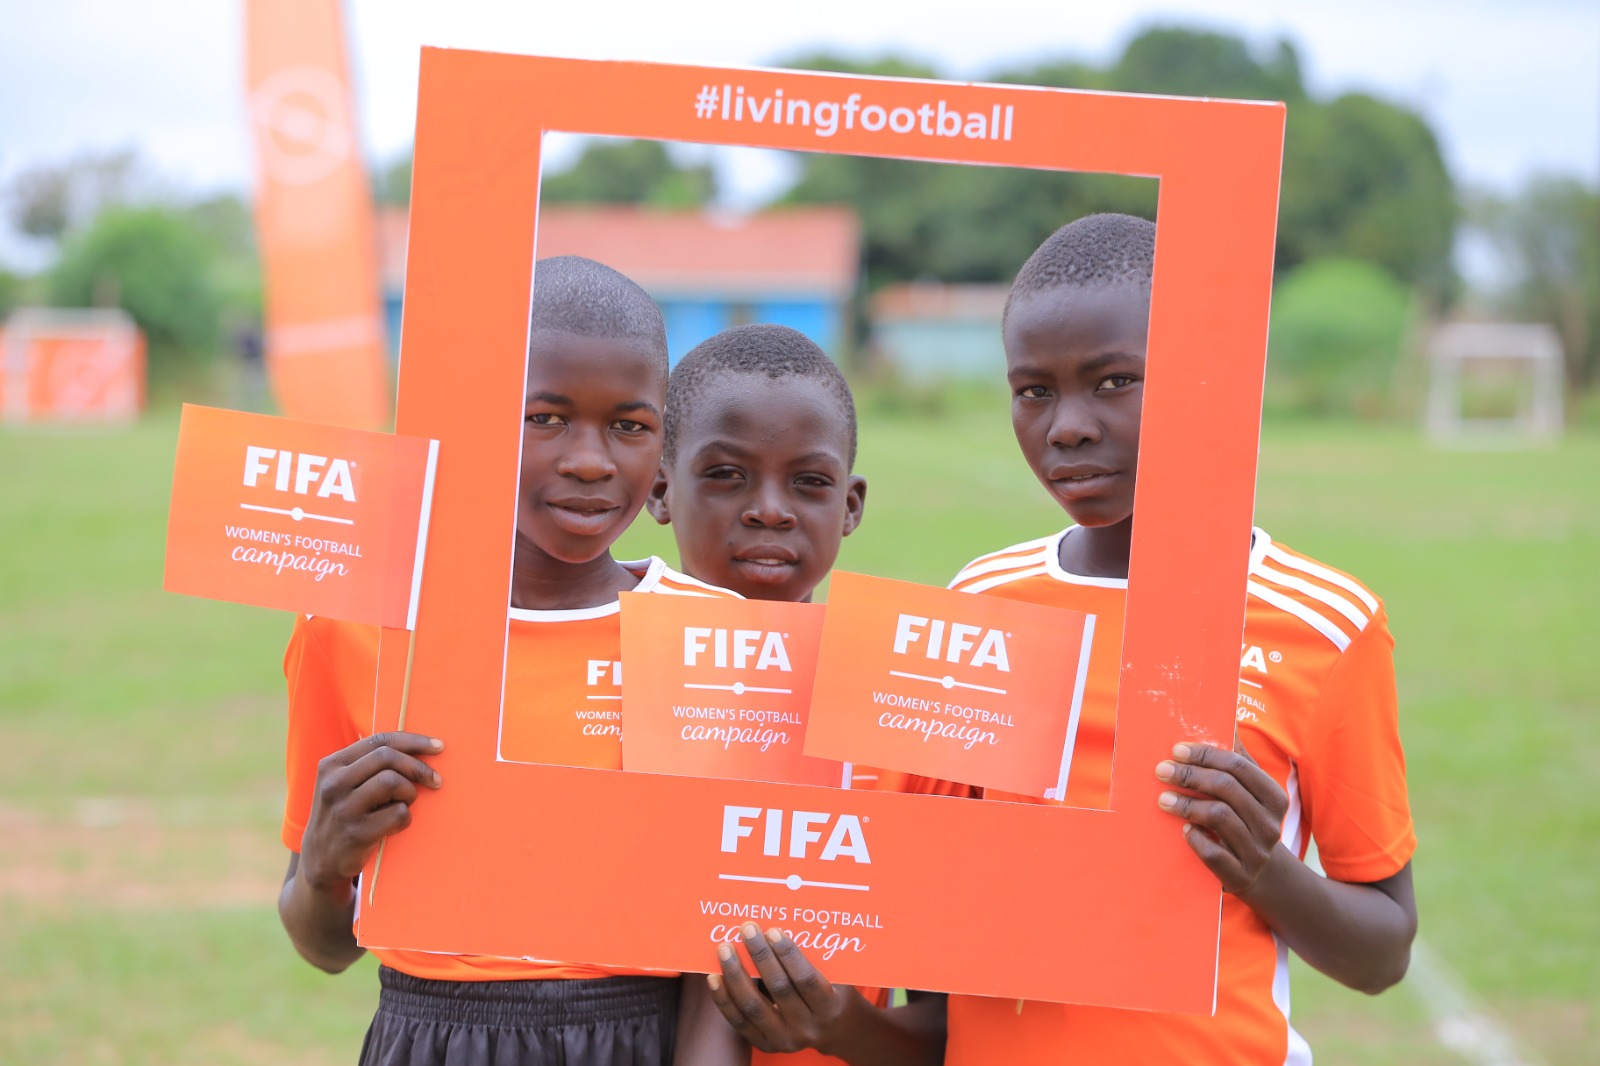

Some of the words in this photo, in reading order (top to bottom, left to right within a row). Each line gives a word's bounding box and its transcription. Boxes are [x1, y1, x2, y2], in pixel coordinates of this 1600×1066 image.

[694, 84, 1015, 141] #livingfootball
[225, 525, 292, 546] WOMEN'S
[294, 535, 363, 558] FOOTBALL
[231, 545, 349, 582] campaign
[672, 705, 736, 721] WOMEN'S
[739, 709, 802, 725] FOOTBALL
[872, 691, 941, 714] WOMEN'S
[944, 703, 1014, 727] FOOTBALL
[680, 722, 790, 752] campaign
[878, 711, 999, 750] campaign
[699, 900, 787, 920] WOMEN'S
[792, 907, 884, 929] FOOTBALL
[709, 924, 867, 961] caaign
